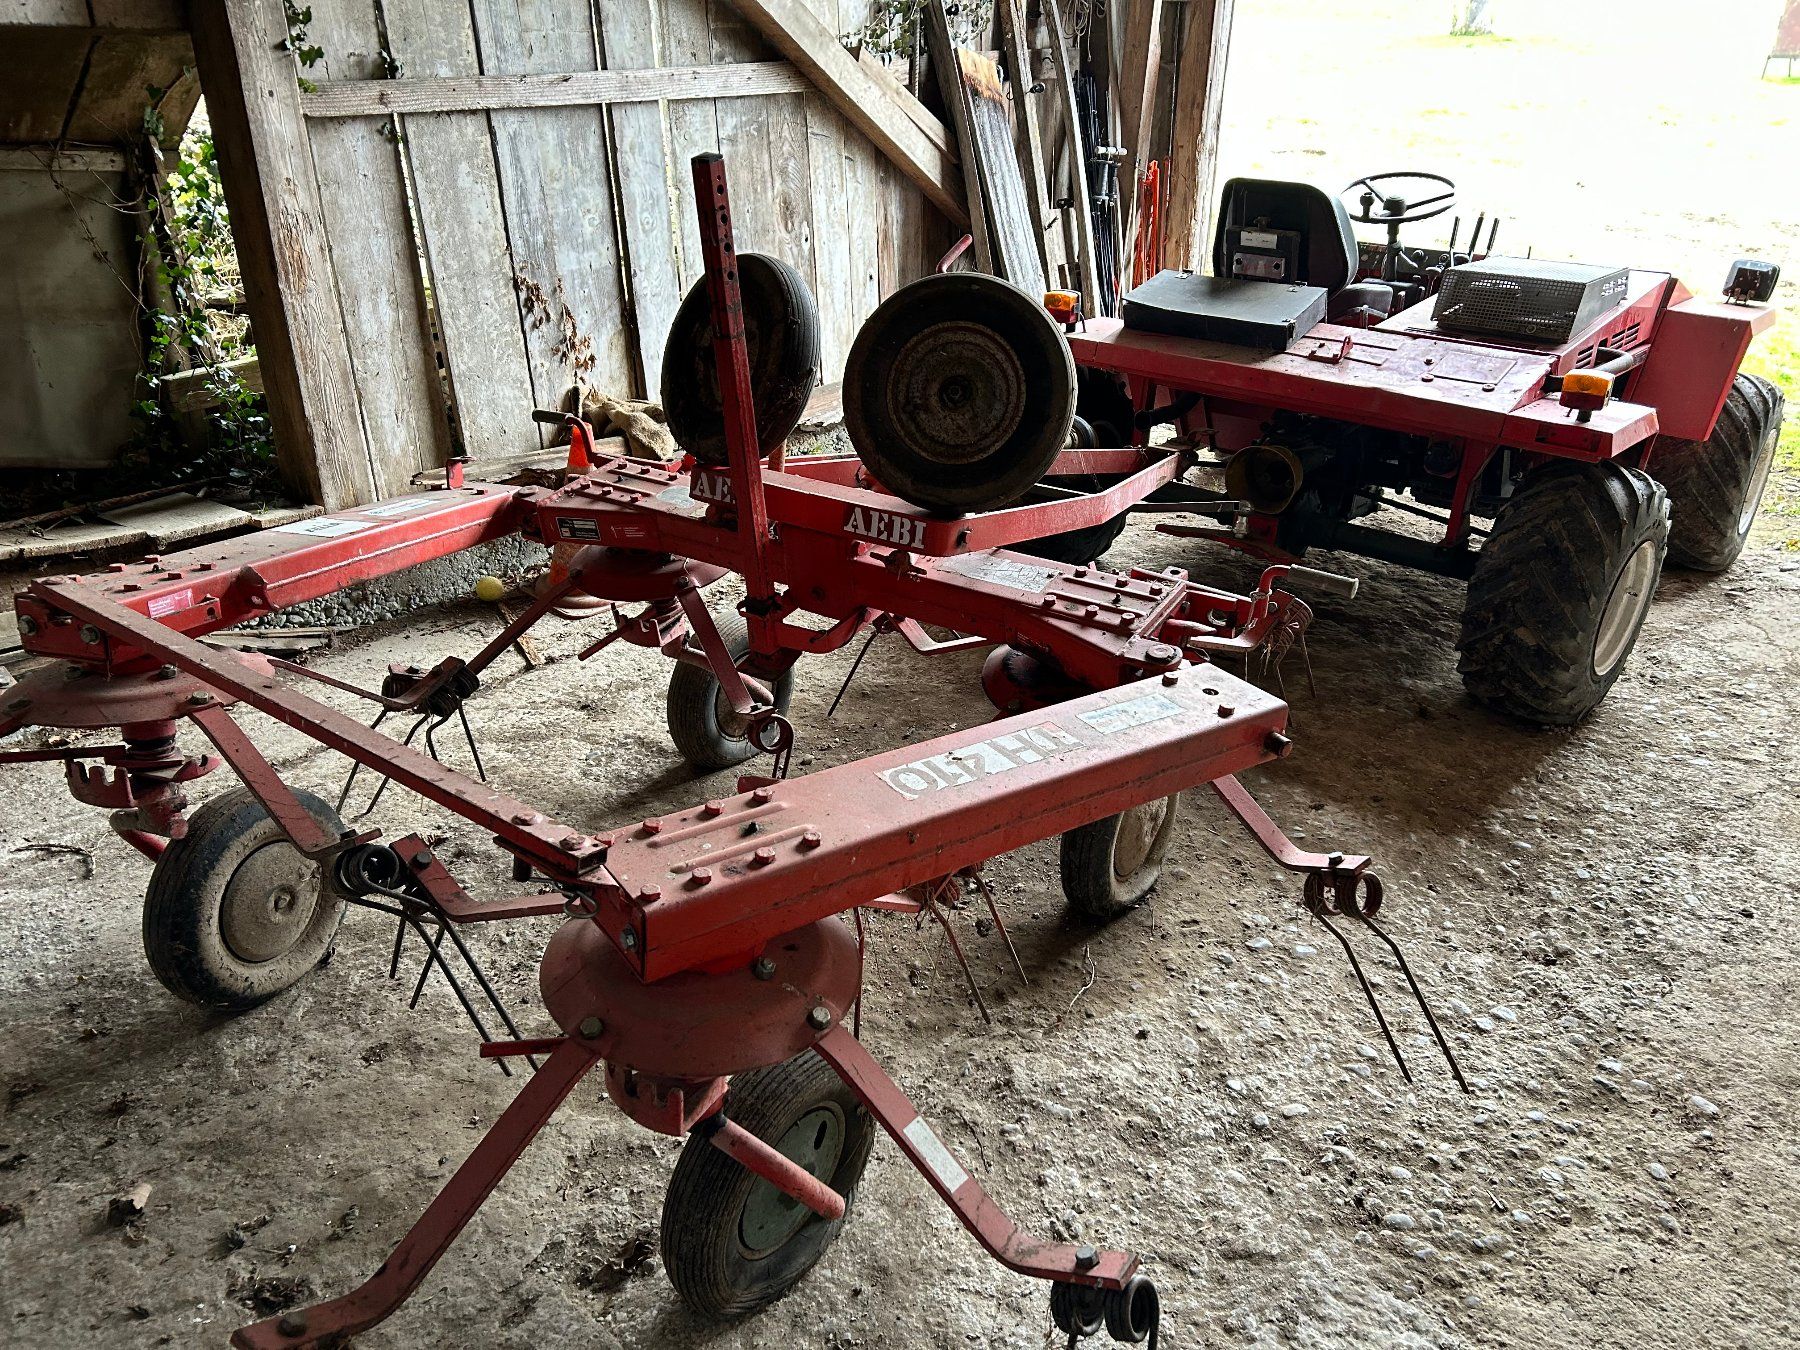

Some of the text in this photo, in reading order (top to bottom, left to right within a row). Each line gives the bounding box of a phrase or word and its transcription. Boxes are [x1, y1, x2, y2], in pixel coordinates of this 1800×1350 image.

[693, 471, 736, 504] AE
[843, 506, 927, 549] AEBI
[888, 726, 1086, 797] TH 410
